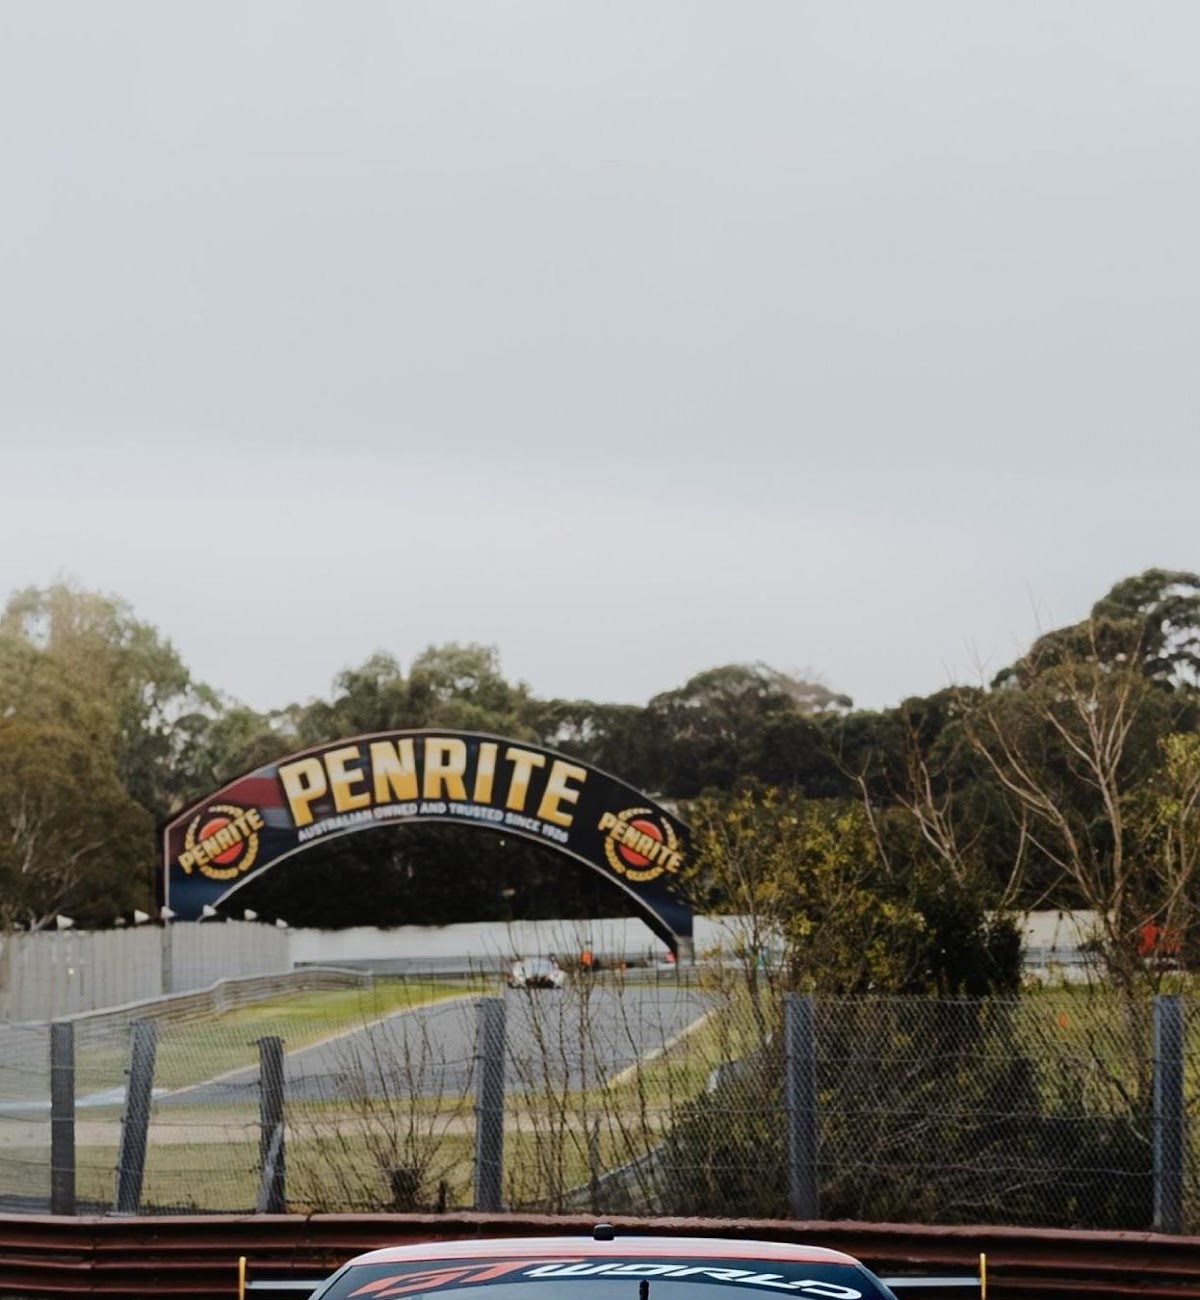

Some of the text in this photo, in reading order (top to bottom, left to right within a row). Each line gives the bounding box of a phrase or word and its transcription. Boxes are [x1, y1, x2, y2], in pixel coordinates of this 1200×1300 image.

[278, 736, 588, 827] PENRITE
[178, 808, 264, 874] PENRITE
[298, 807, 373, 842] AUSTRALIAN
[373, 802, 417, 819] OWNED
[420, 801, 447, 814] AND
[448, 802, 504, 822] TRUSTED
[505, 812, 542, 832] SINCE
[598, 812, 685, 873] PENRITE
[348, 1258, 863, 1300] GT WORLD
